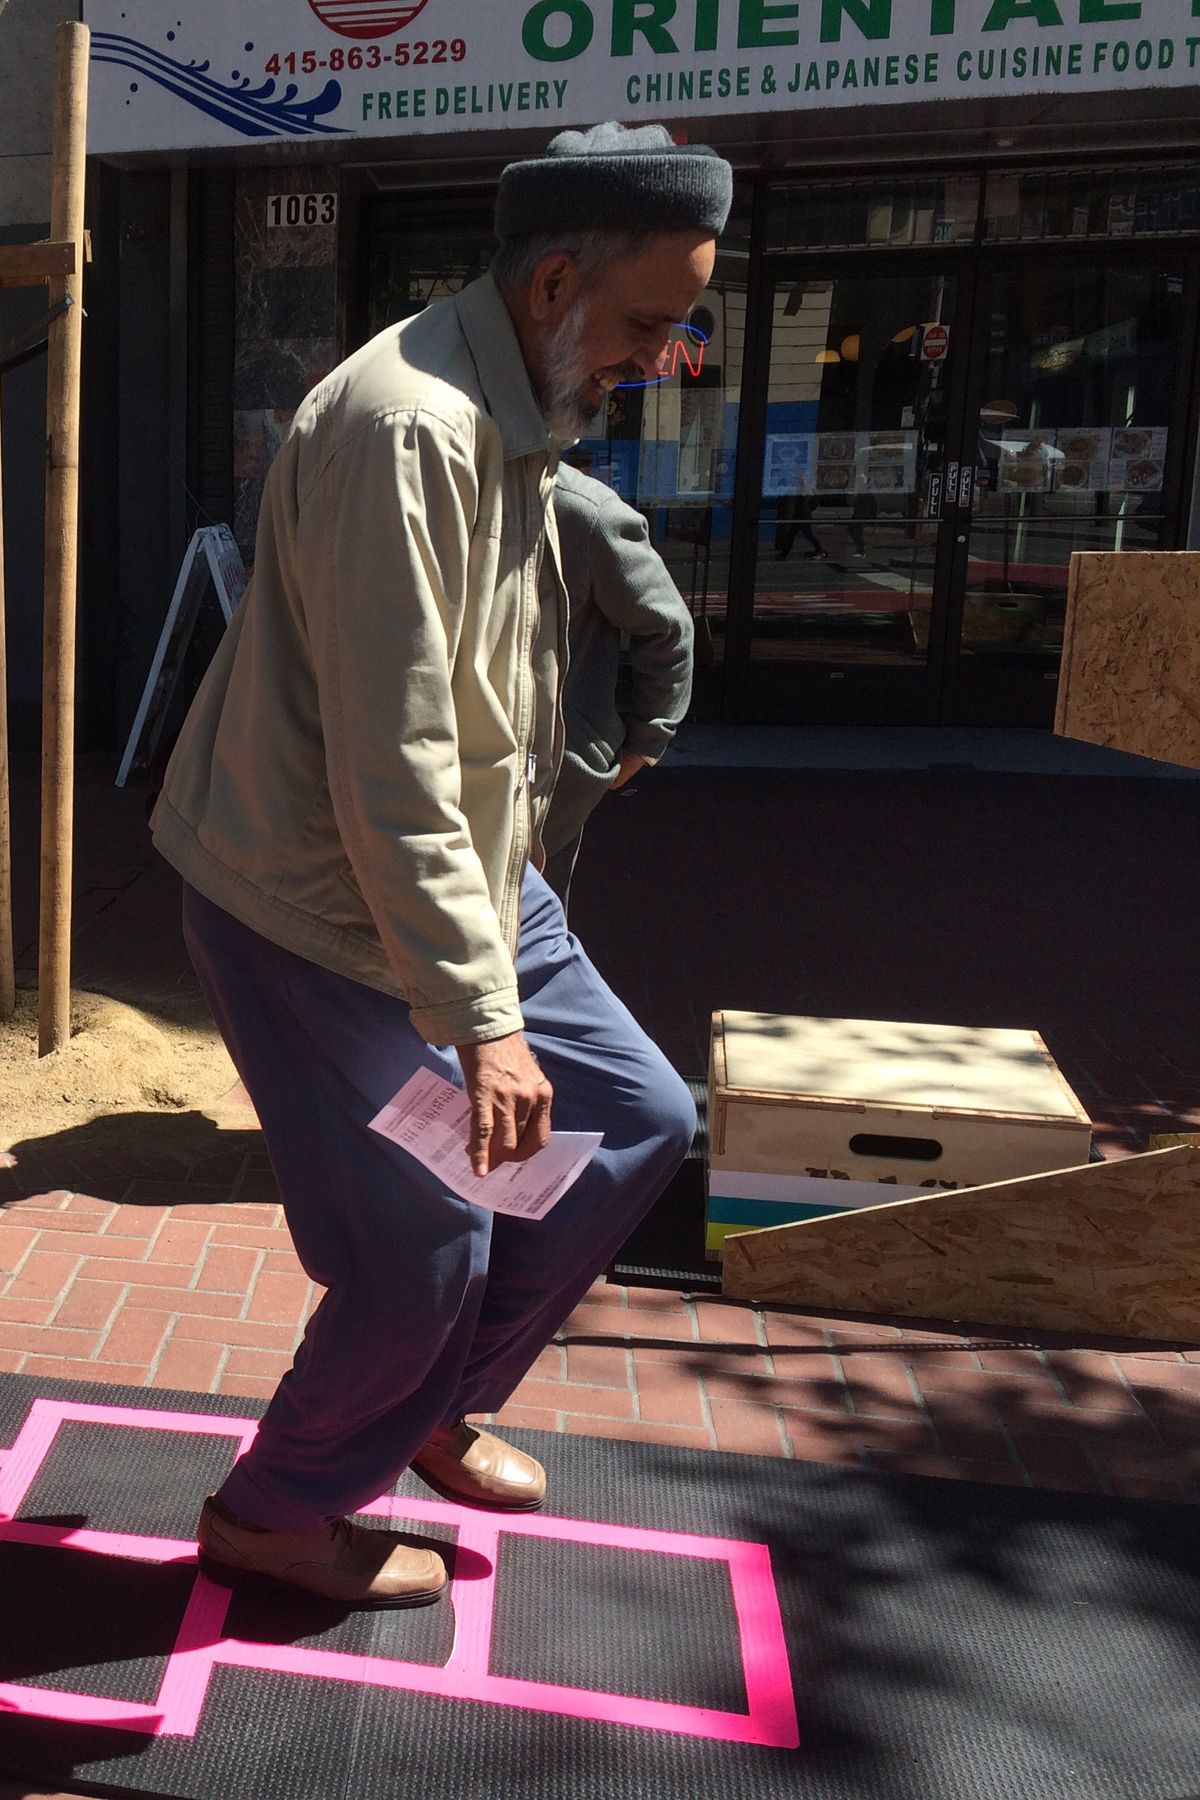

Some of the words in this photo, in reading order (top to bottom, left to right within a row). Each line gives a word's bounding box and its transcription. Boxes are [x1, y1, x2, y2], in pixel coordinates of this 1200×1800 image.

[265, 38, 467, 75] 415-863-5229
[626, 66, 750, 104] CHINESE
[760, 64, 777, 94] &
[787, 53, 939, 92] JAPANESE
[956, 43, 1083, 82] CUISINE
[1093, 38, 1175, 73] FOOD
[362, 88, 426, 120] FREE
[435, 79, 569, 115] DELIVERY
[271, 194, 335, 225] 1063
[930, 478, 940, 515] PULL
